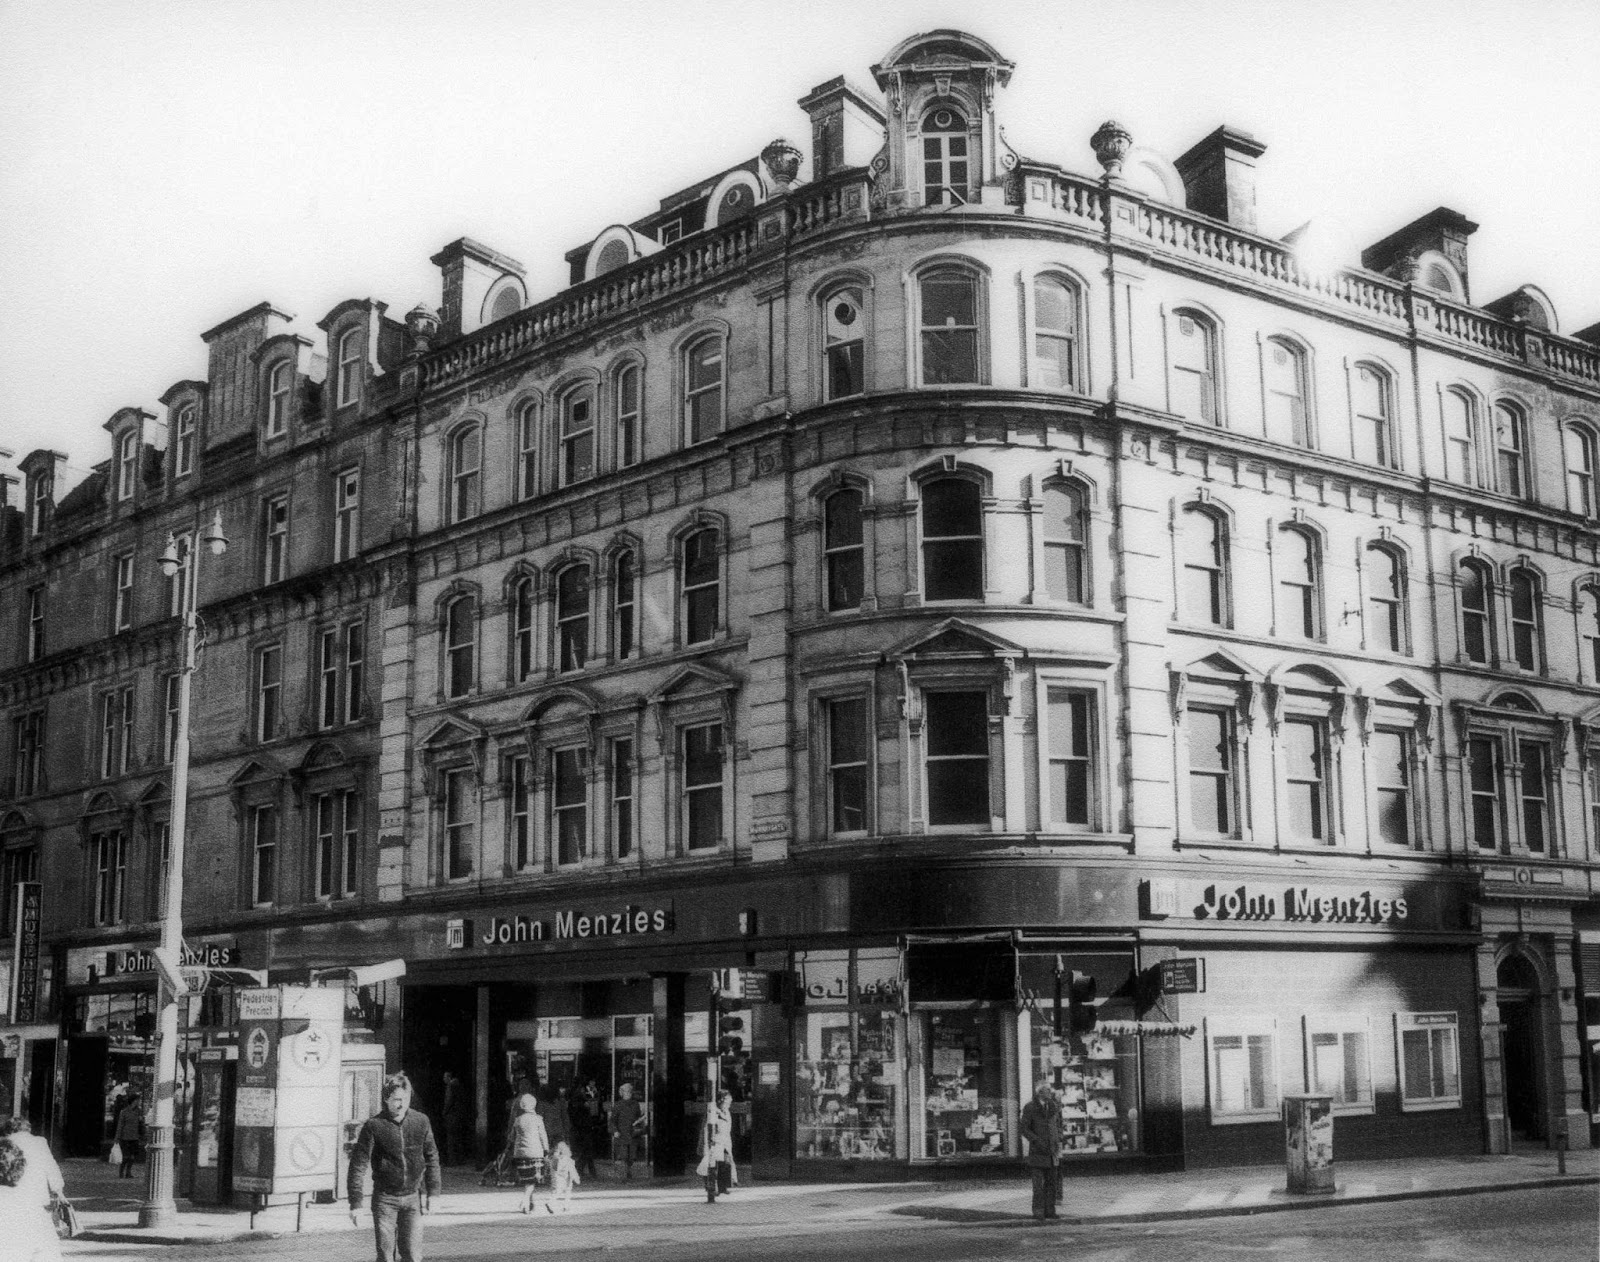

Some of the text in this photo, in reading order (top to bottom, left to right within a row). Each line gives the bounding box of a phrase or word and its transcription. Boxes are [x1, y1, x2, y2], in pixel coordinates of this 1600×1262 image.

[1199, 885, 1408, 920] John Menzies
[483, 904, 665, 944] John Menzies
[179, 944, 230, 966] enzies
[242, 992, 278, 1004] Pedestrian
[245, 1005, 273, 1016] Precinct
